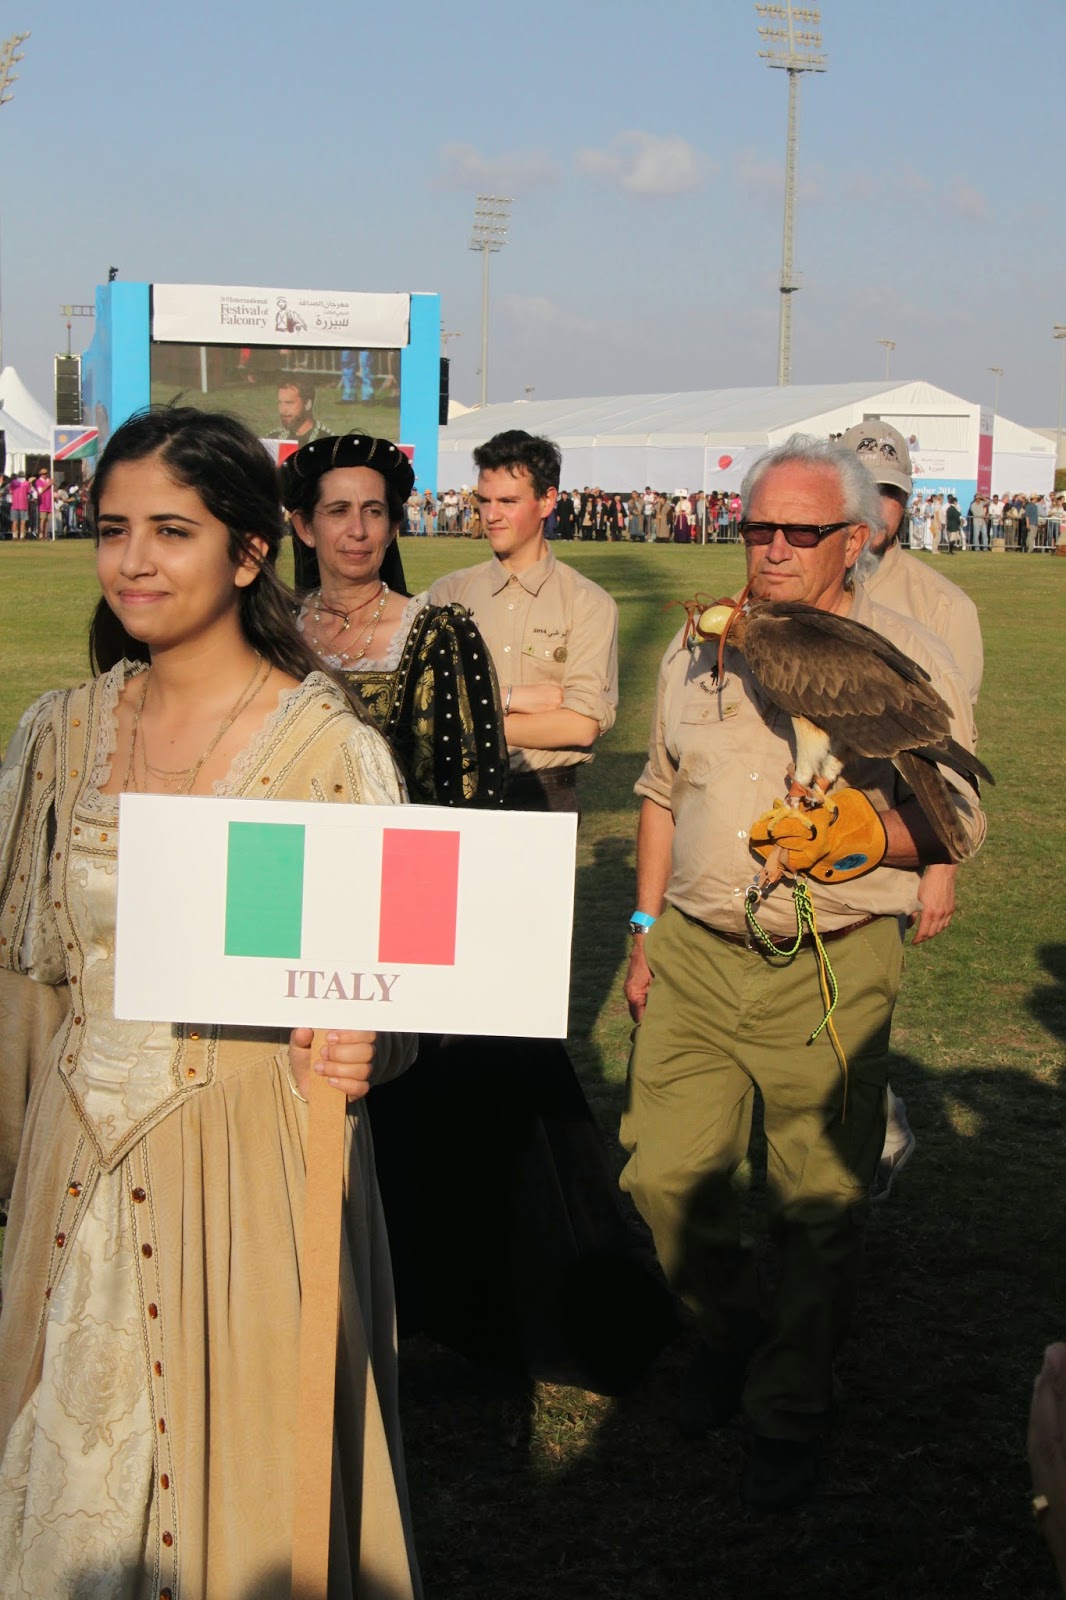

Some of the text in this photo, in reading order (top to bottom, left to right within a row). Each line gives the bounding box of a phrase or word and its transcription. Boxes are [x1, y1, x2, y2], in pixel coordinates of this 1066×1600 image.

[230, 296, 268, 304] International
[220, 303, 260, 315] Festival
[220, 313, 267, 328] Falconry
[315, 314, 349, 330] للبيزرة
[912, 486, 956, 495] ember 2014
[284, 969, 401, 1003] ITALY
